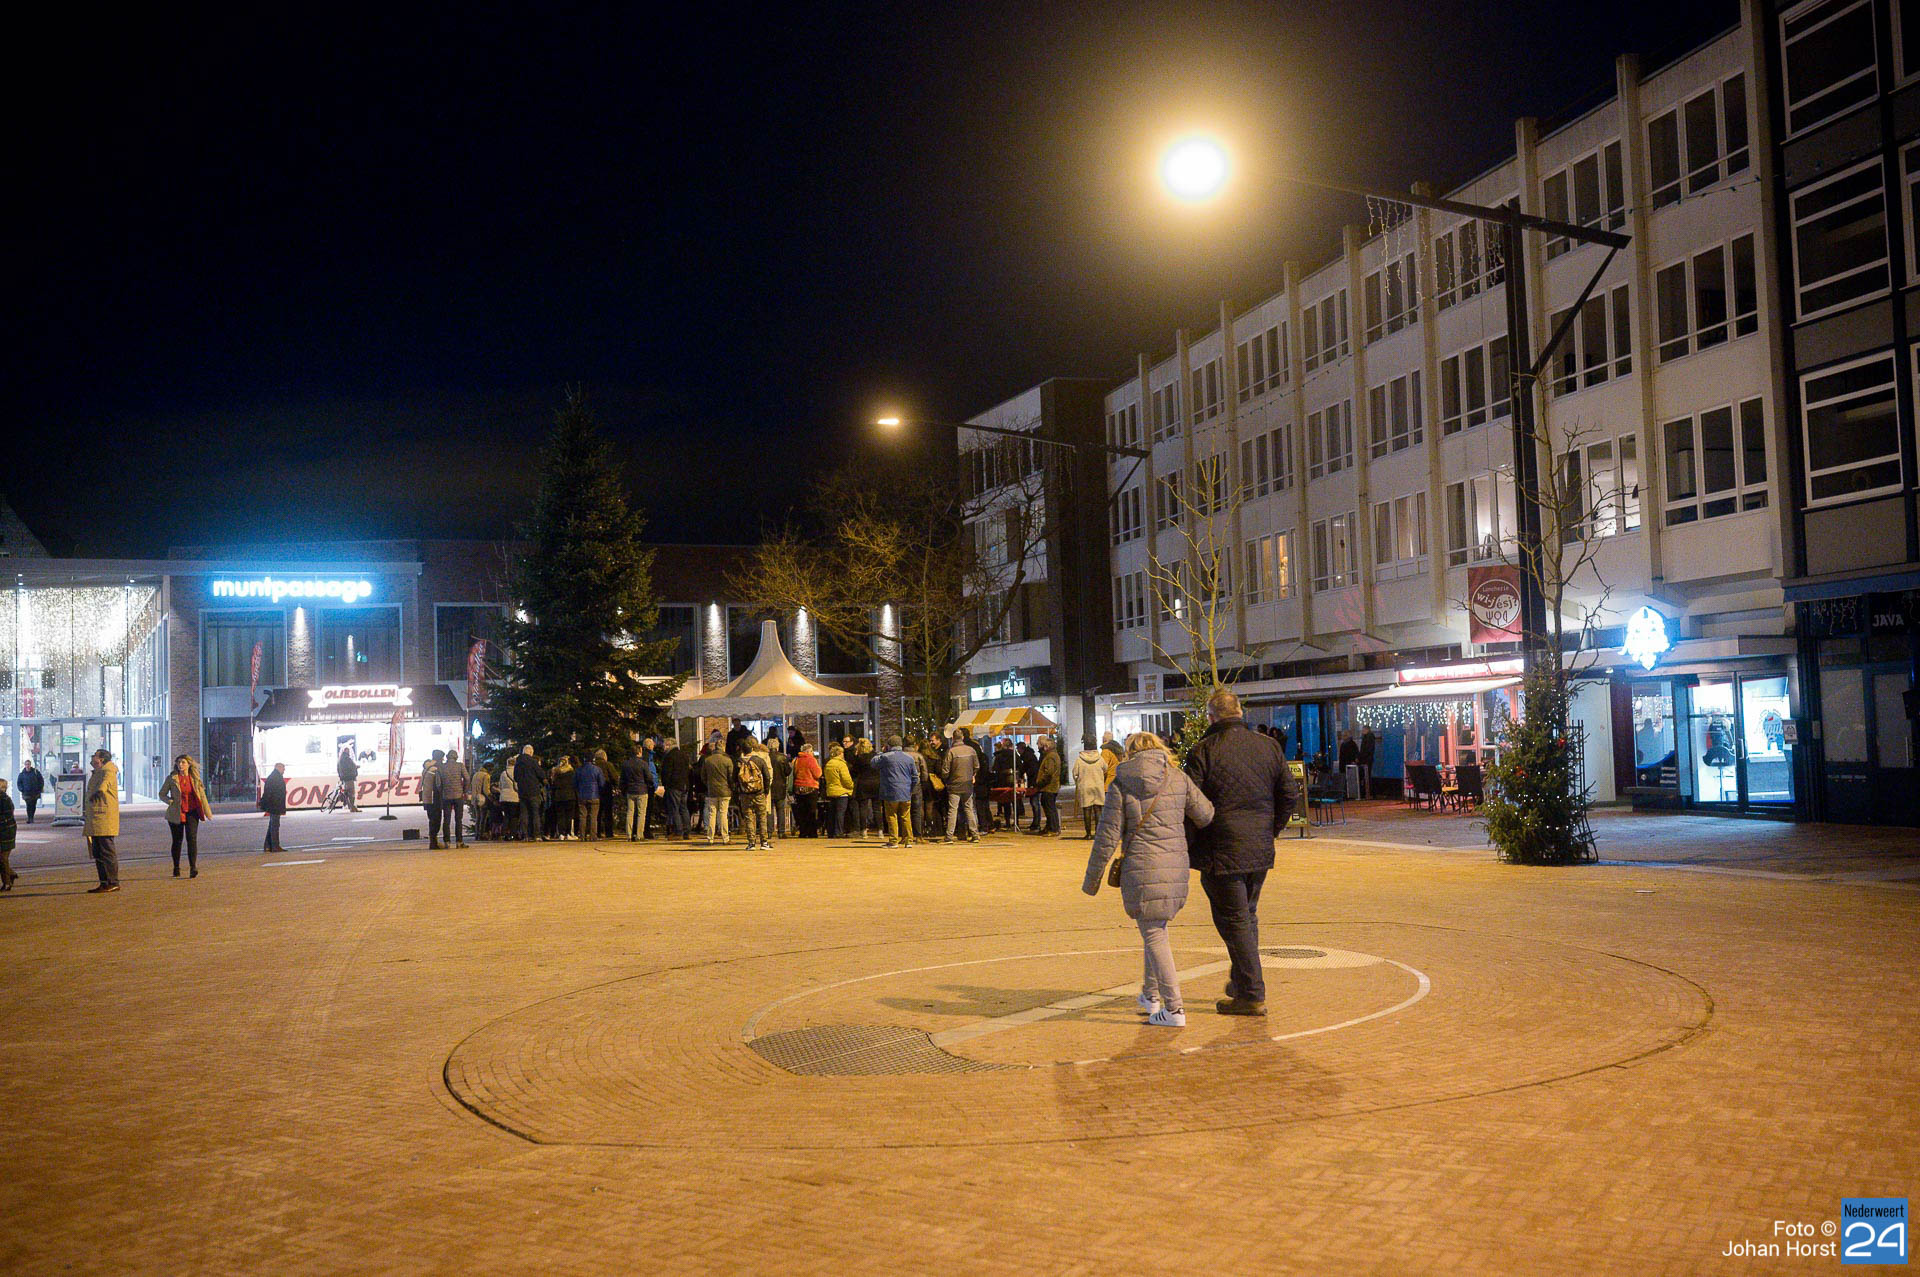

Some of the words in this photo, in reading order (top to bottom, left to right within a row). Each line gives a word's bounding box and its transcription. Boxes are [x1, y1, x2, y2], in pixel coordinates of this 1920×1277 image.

[213, 576, 372, 604] muntpassage
[1872, 614, 1904, 627] JAVA
[324, 688, 396, 700] OLIEBOLLEN
[287, 784, 329, 806] ON
